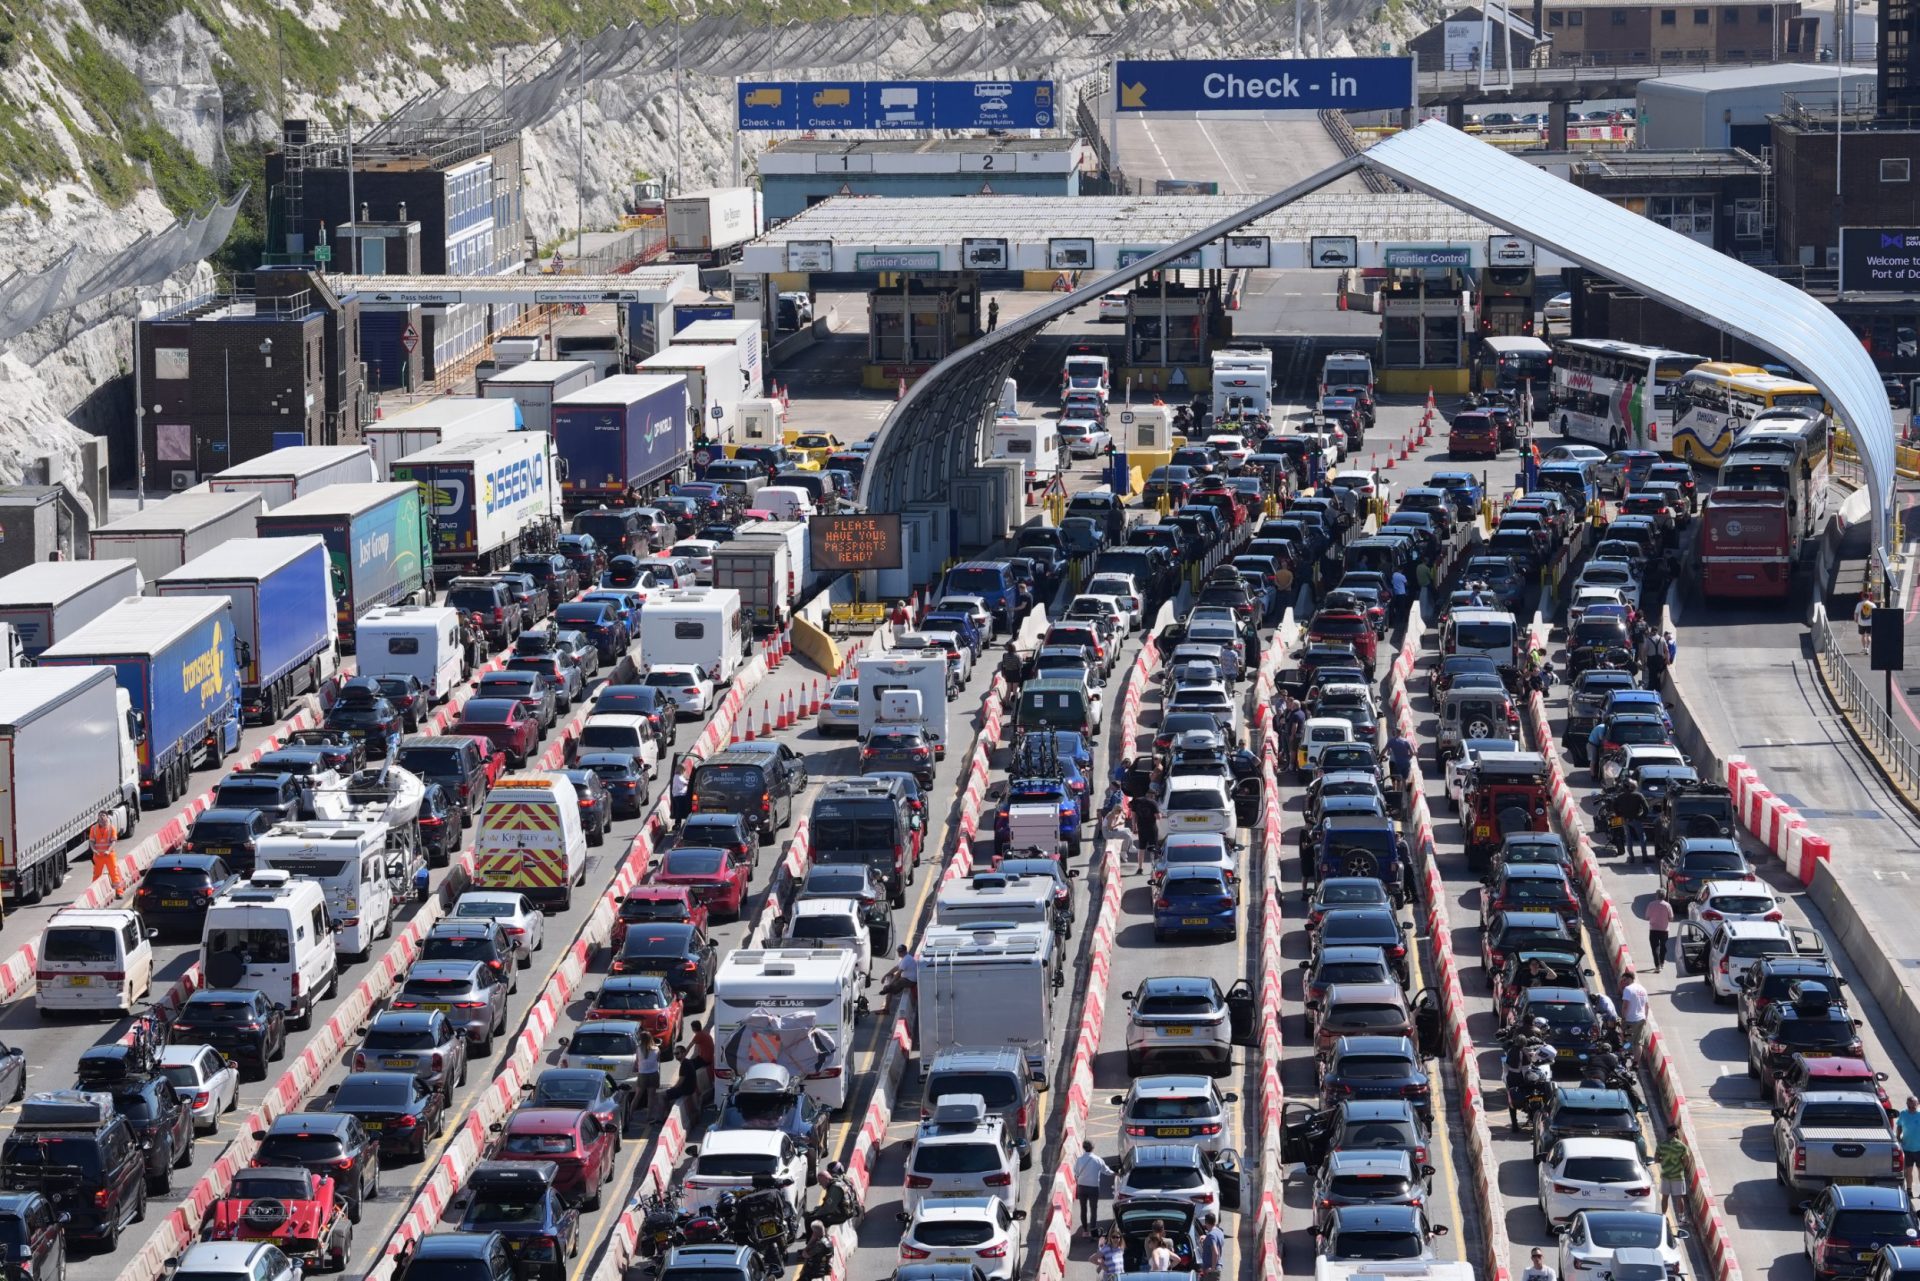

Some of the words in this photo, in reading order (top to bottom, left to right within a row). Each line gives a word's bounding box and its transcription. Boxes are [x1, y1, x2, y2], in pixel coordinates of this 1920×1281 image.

[1203, 72, 1300, 99] Check
[1331, 72, 1357, 97] in
[742, 118, 769, 126] Check
[777, 118, 785, 126] In
[808, 118, 836, 126] Check
[844, 118, 852, 126] In
[841, 155, 848, 170] 1
[982, 155, 994, 170] 2
[859, 257, 897, 267] Frontier
[900, 256, 936, 266] Control
[1390, 254, 1427, 263] Frontier
[1430, 254, 1467, 263] Control
[1866, 256, 1910, 266] Welcome
[1872, 269, 1892, 279] Port
[1895, 269, 1905, 279] of
[661, 416, 672, 436] WORLD
[486, 453, 543, 515] DISSEGNA
[834, 520, 876, 531] PLEASE
[826, 531, 853, 541] HAVE
[858, 530, 887, 541] YOUR
[371, 531, 390, 562] Group
[824, 541, 887, 552] PASSPORTS
[838, 551, 873, 562] READY
